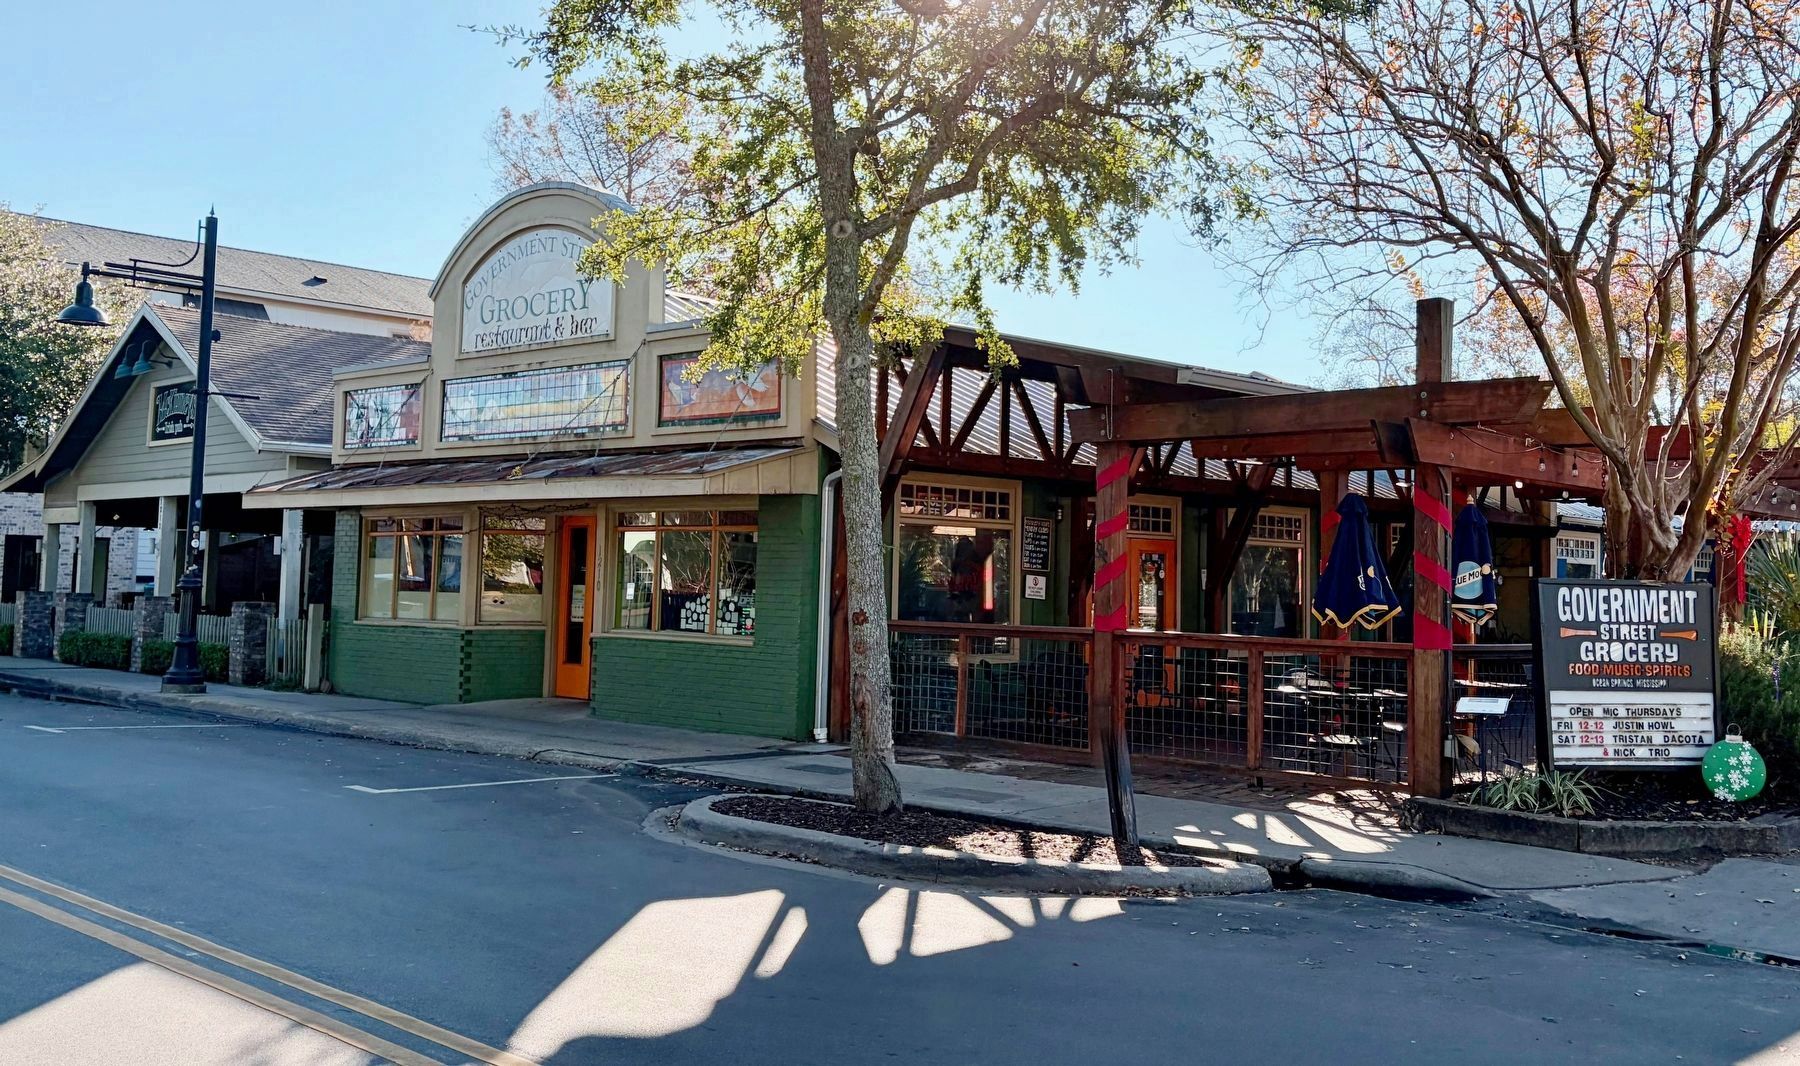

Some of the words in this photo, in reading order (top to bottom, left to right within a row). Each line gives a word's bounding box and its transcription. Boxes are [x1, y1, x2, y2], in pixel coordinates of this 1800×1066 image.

[464, 236, 558, 310] GOVERNMENT
[480, 279, 592, 325] GROCERY
[474, 318, 551, 349] restaurant
[570, 315, 598, 337] bar
[1557, 586, 1698, 624] GOVERNMENT
[1600, 623, 1657, 641] STREET
[1579, 641, 1679, 663] GROCERY
[1569, 663, 1600, 676] FOOD
[1611, 678, 1634, 687] SPRINGS
[1569, 707, 1594, 717] OPEN
[1603, 707, 1619, 717] MIC
[1625, 707, 1682, 717] THURSDAYS
[1557, 722, 1573, 730] FRI
[1579, 721, 1604, 730] 12-12
[1612, 721, 1644, 730] JUSTIN
[1648, 721, 1675, 730] HOWL
[1557, 735, 1576, 744] SAT
[1579, 735, 1605, 744] 12-13
[1612, 735, 1653, 744] TRISTAN
[1663, 735, 1704, 744] DACOTA
[1602, 748, 1609, 757] &
[1613, 748, 1636, 757] NICK
[1648, 748, 1671, 757] TRIO
